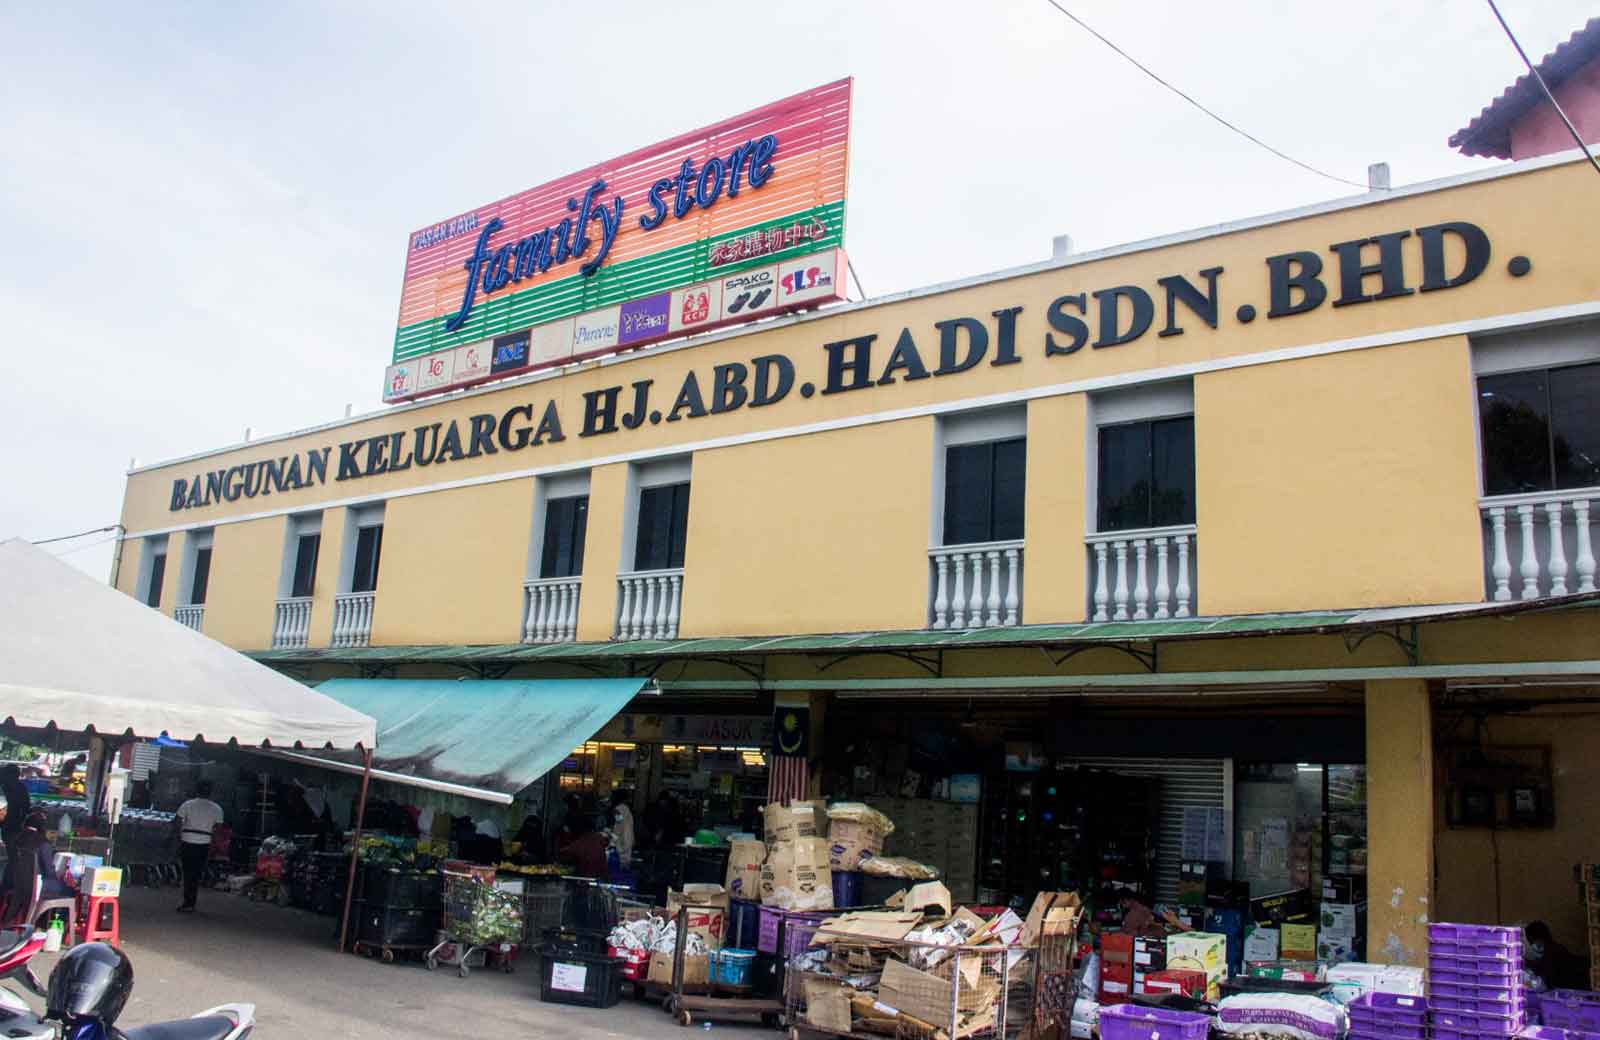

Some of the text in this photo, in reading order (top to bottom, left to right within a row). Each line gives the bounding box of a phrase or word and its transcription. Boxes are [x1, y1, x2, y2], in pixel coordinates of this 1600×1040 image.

[446, 134, 778, 331] family store
[725, 271, 770, 289] SPAKO
[170, 447, 332, 511] BANGUNAN
[336, 400, 566, 481] KELUARGA
